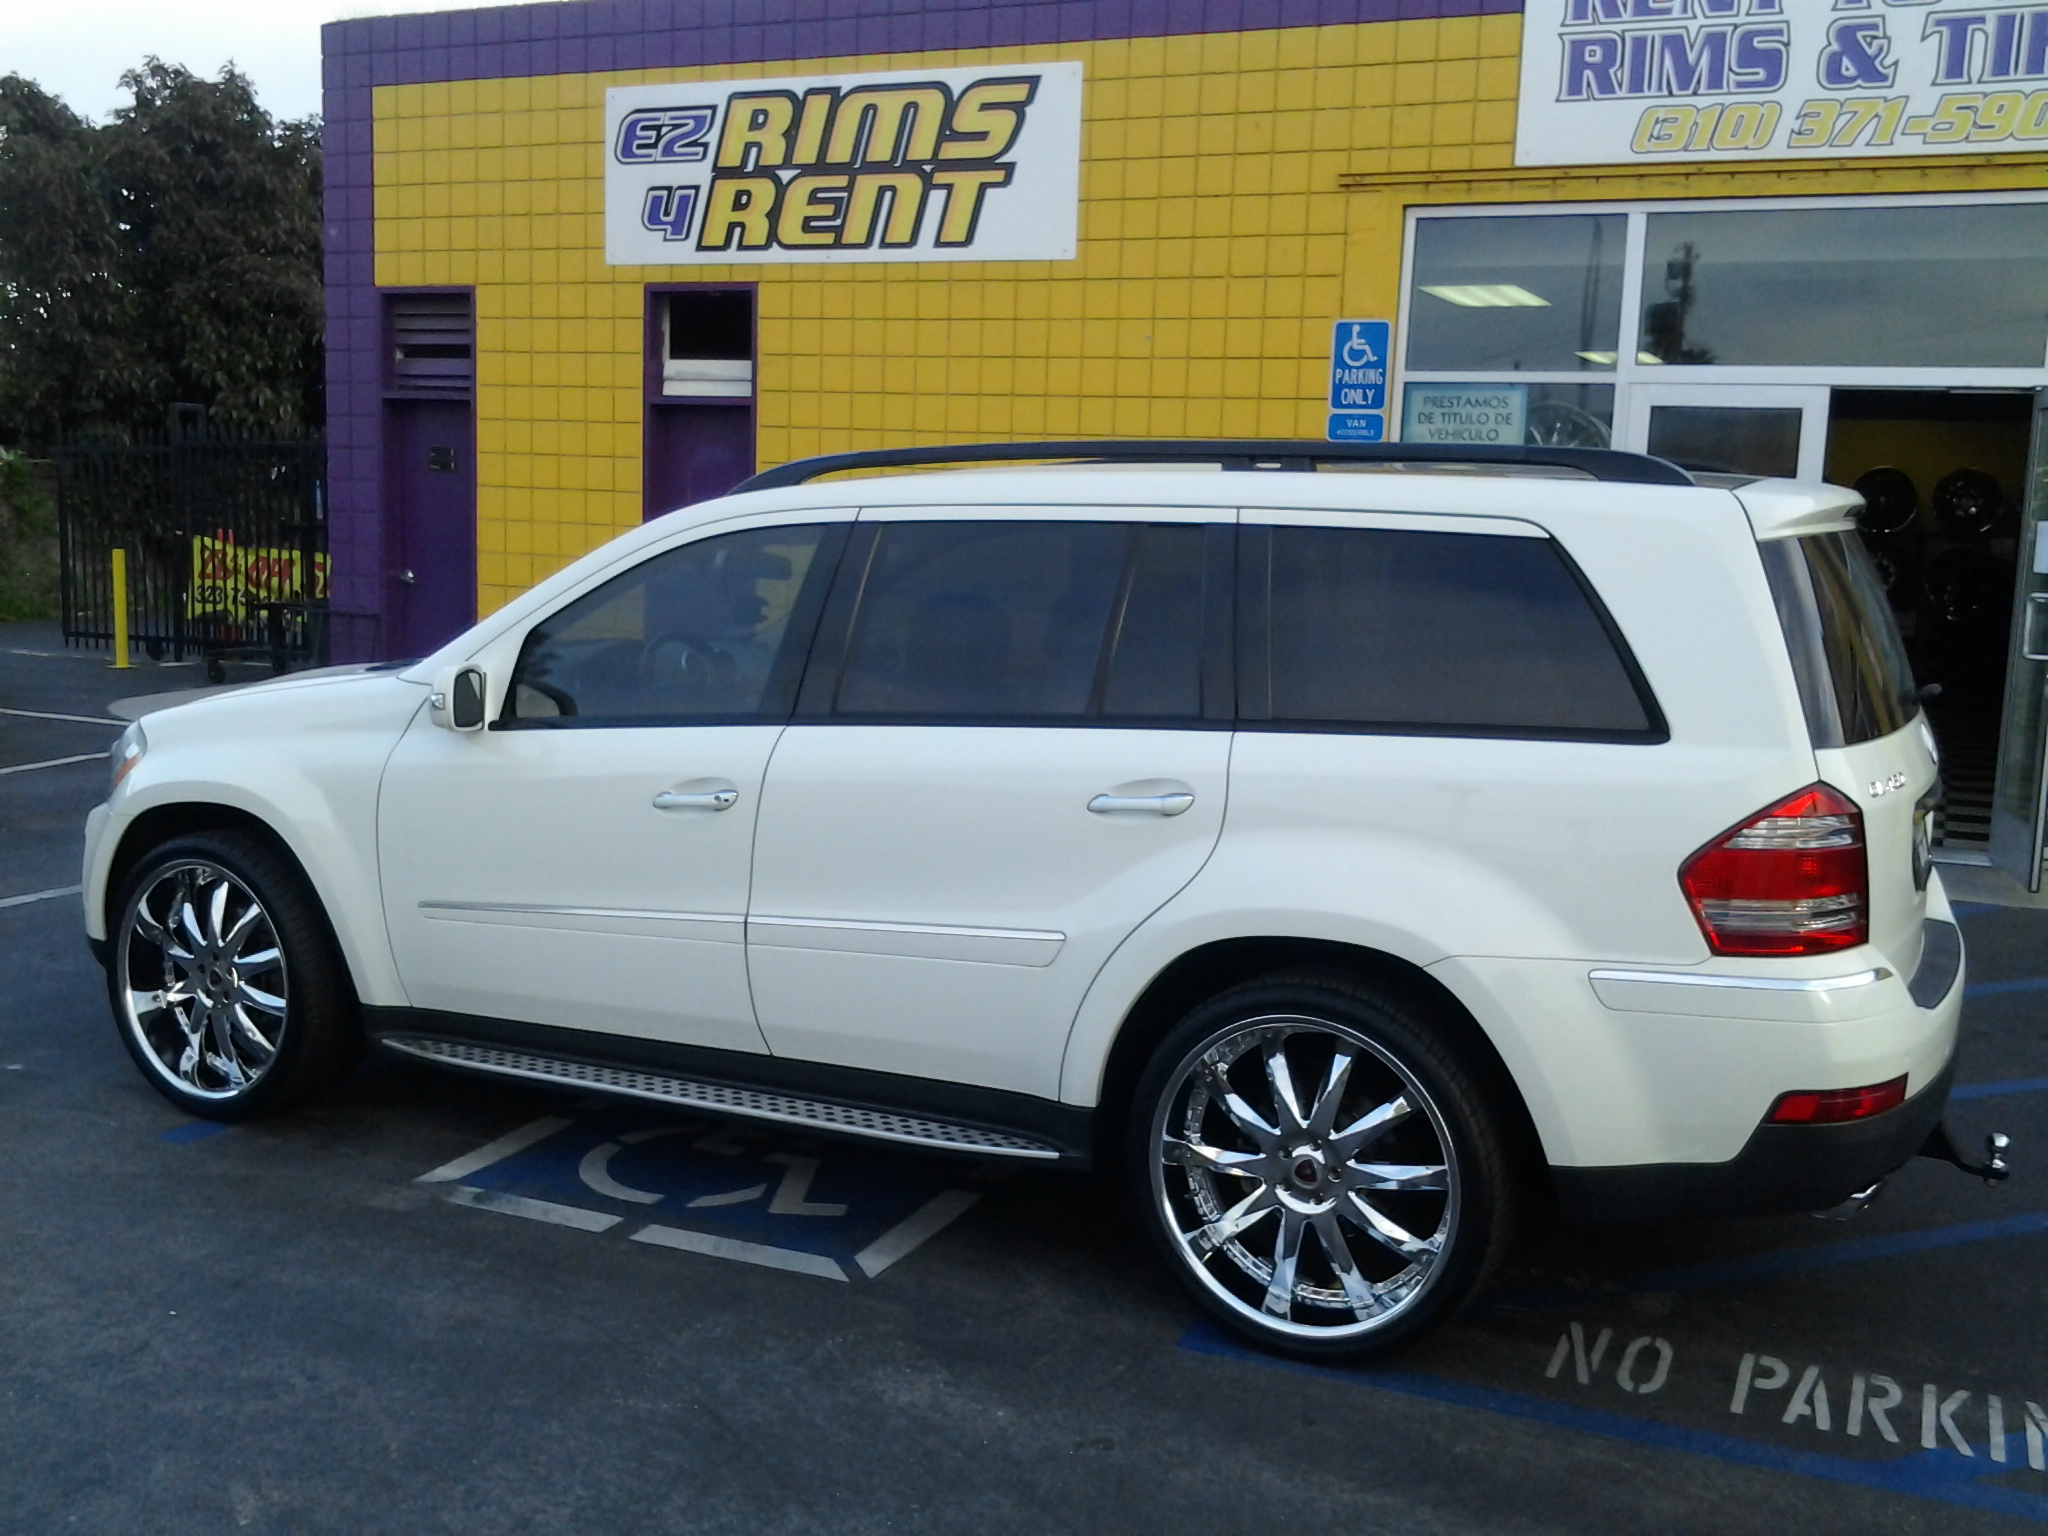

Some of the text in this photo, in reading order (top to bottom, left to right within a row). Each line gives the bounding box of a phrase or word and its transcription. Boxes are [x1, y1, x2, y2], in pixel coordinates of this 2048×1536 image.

[1556, 22, 1790, 102] RIMS
[1817, 16, 1900, 91] &
[614, 75, 1042, 174] EZ RIMS
[1630, 101, 1783, 154] (310)
[642, 163, 1017, 252] 4 RENT
[1335, 368, 1384, 385] PARKING
[1341, 388, 1376, 405] ONLY
[1346, 418, 1367, 429] VAN
[1417, 411, 1513, 426] DE TITULO DE
[1545, 1321, 1674, 1394] NO
